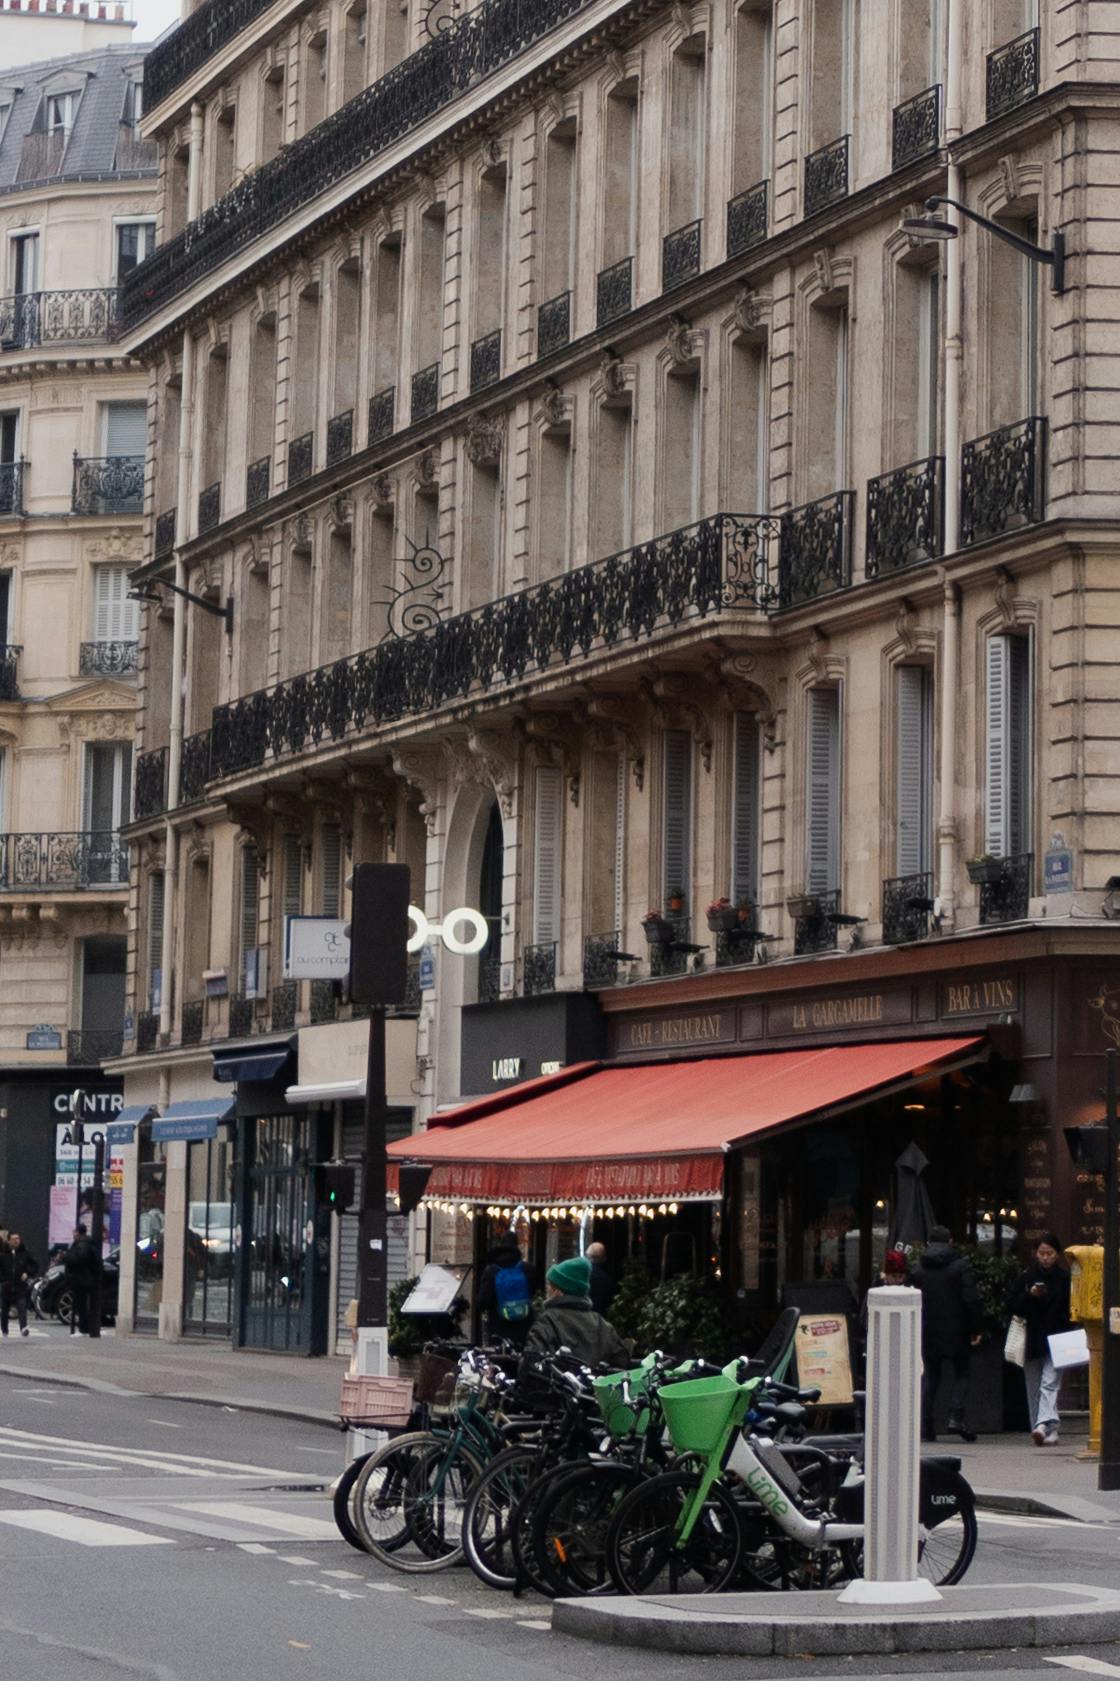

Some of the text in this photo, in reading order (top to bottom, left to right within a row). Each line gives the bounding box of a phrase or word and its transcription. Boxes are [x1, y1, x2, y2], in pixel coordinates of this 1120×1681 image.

[792, 995, 883, 1029] LA GARGAMELLE
[947, 984, 971, 1012] BAR
[983, 979, 1014, 1009] VINS
[661, 1014, 721, 1043] RESTAURANT
[492, 1057, 520, 1080] LARRY
[747, 1466, 789, 1517] Lime
